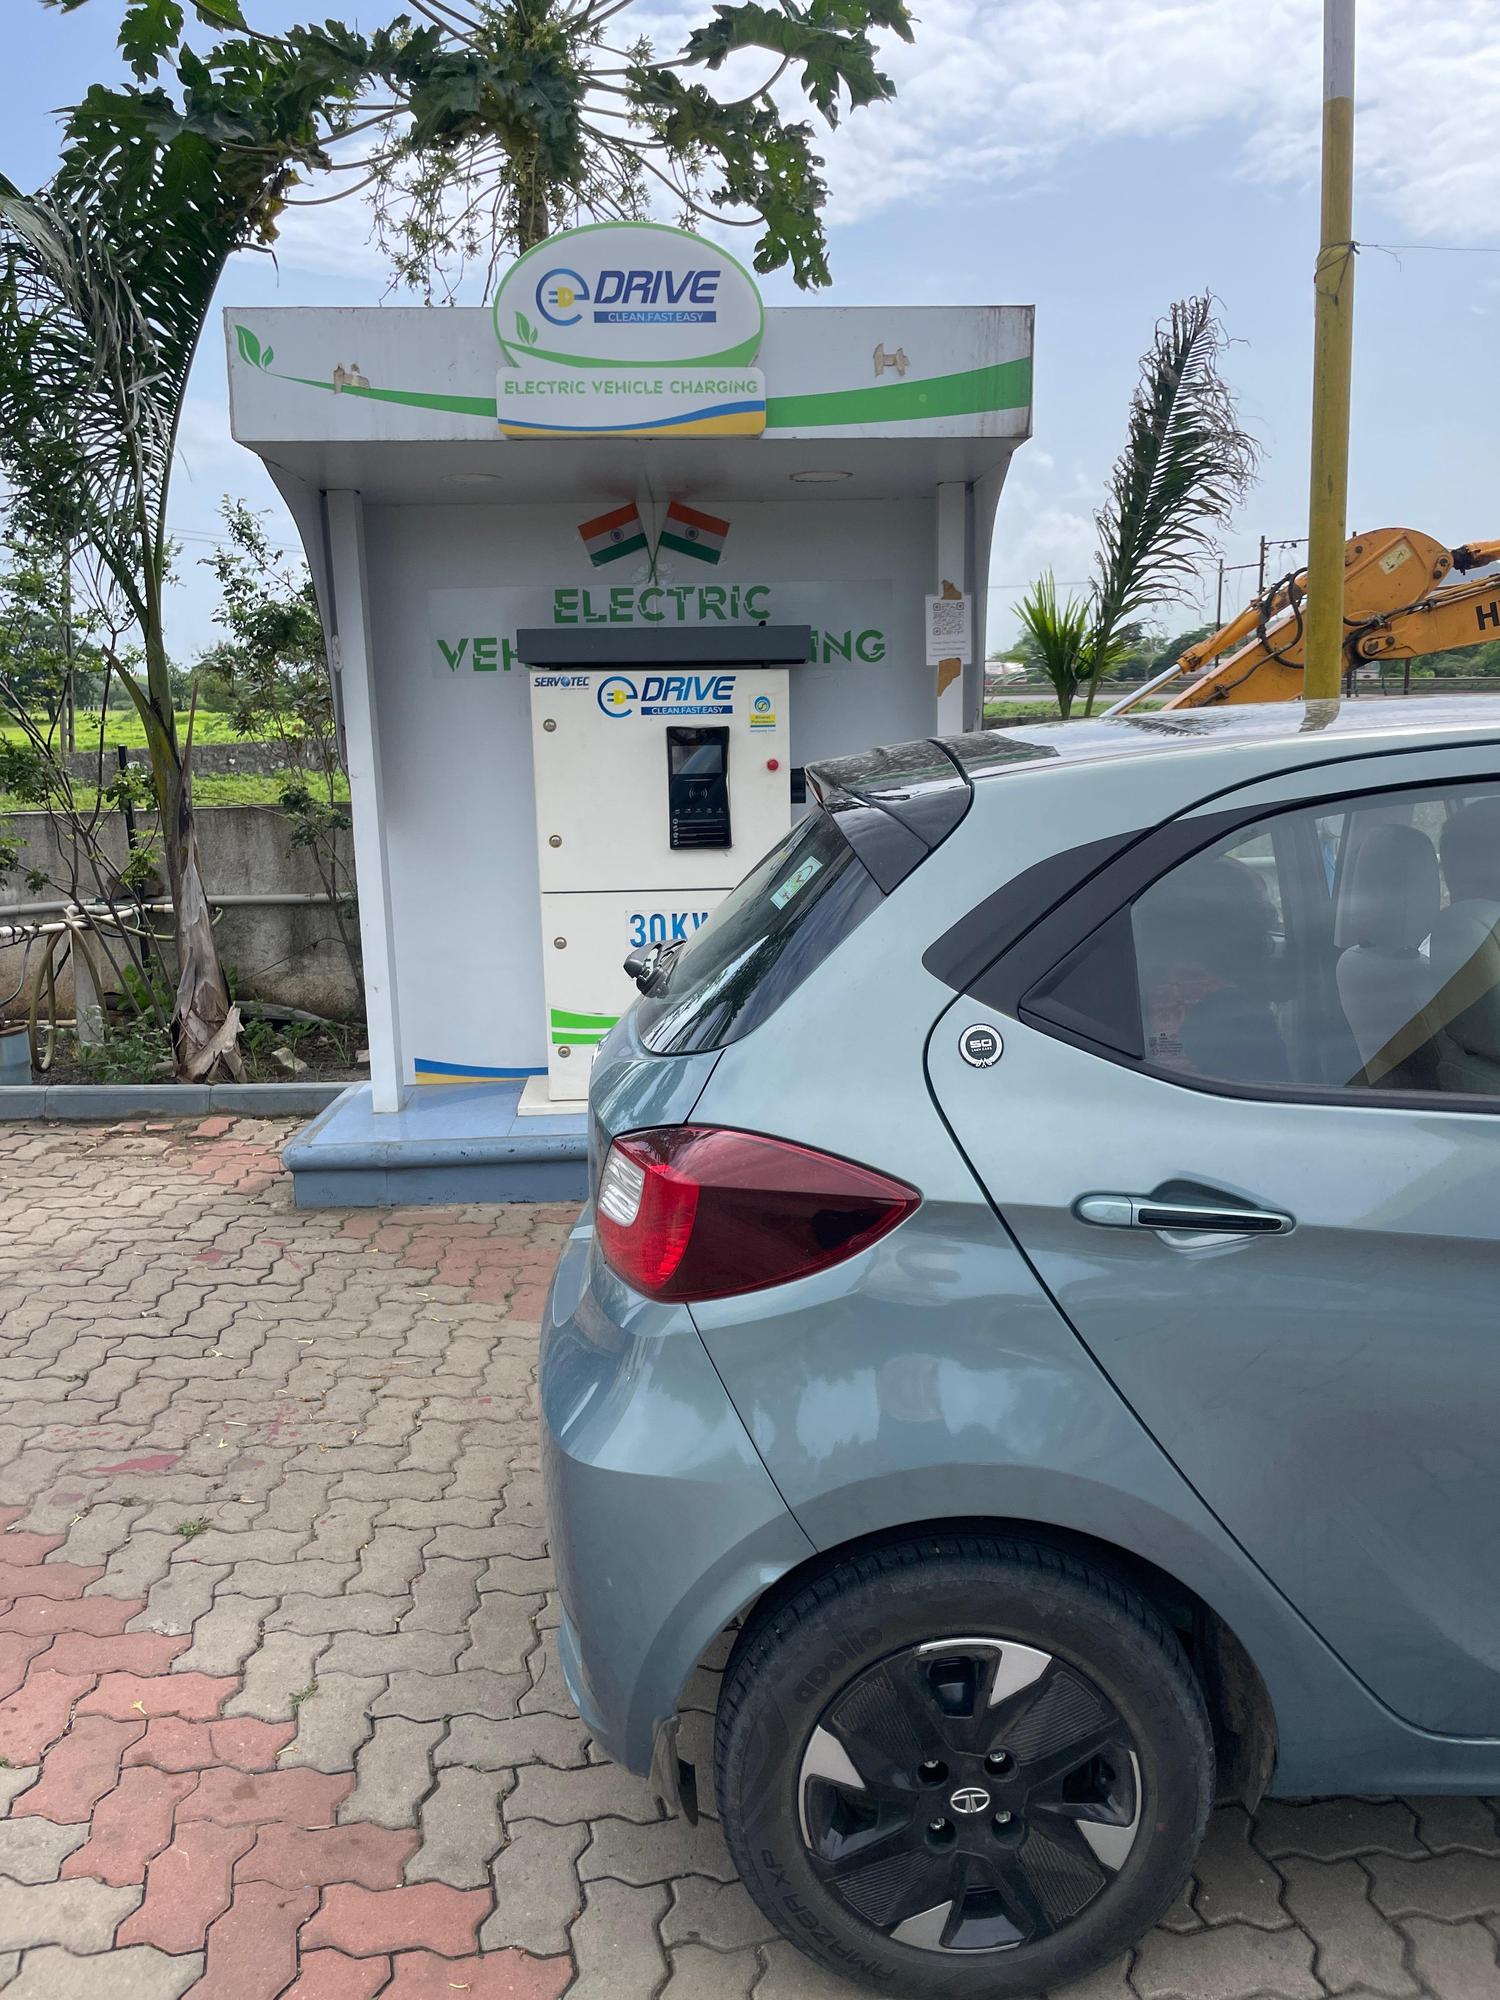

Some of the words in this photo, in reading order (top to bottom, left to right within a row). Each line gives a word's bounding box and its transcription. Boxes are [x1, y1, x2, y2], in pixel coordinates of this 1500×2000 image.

[504, 380, 586, 395] ELECTRIC
[592, 380, 664, 395] VEHICLE
[669, 380, 759, 394] CHARGING
[553, 584, 771, 624] ELECTRIC
[436, 637, 519, 672] VEH
[810, 629, 886, 663] ING
